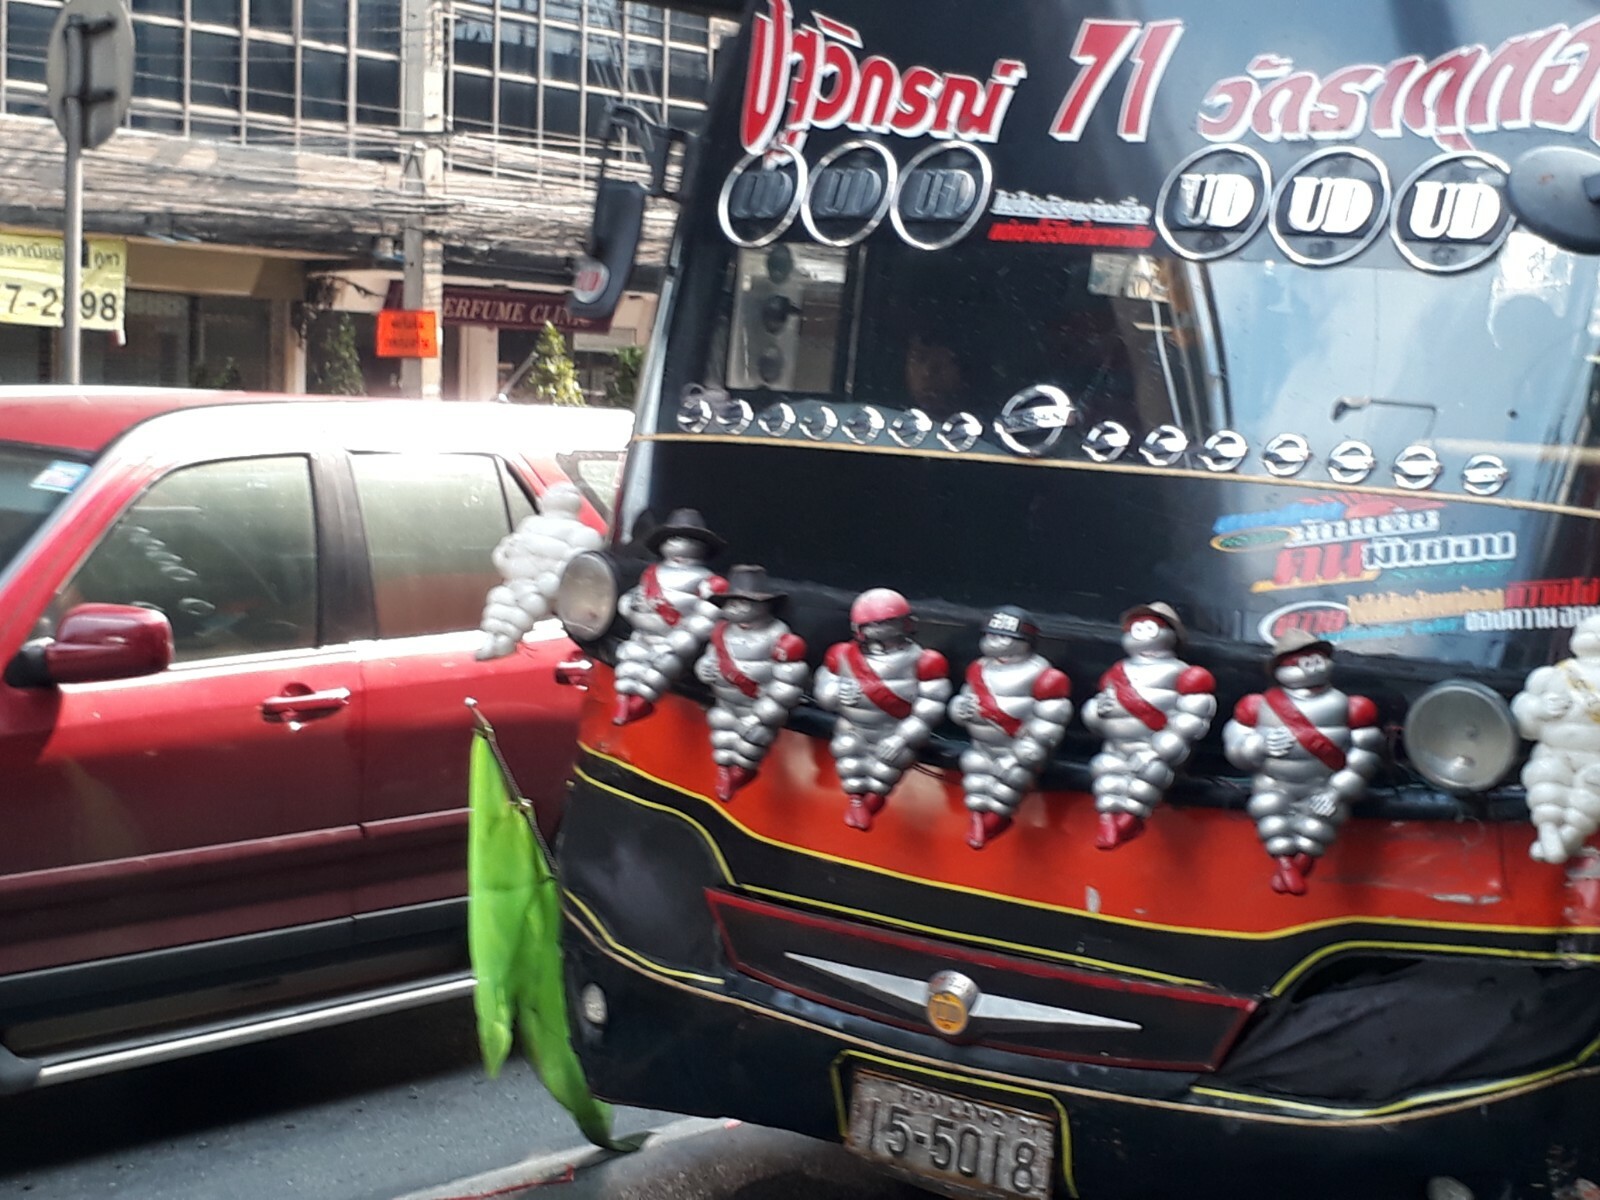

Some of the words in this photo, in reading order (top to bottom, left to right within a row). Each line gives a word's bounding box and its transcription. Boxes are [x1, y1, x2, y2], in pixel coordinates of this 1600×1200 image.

[1049, 18, 1184, 142] 71
[1197, 15, 1600, 152] วัดธาตุทอ
[1178, 173, 1256, 228] UD
[1288, 176, 1374, 234] UD
[1408, 180, 1501, 240] UD
[5, 284, 117, 322] 7-298
[442, 296, 526, 323] ERFUME
[529, 302, 592, 327] CLIN
[869, 1097, 1038, 1194] 15-5018
